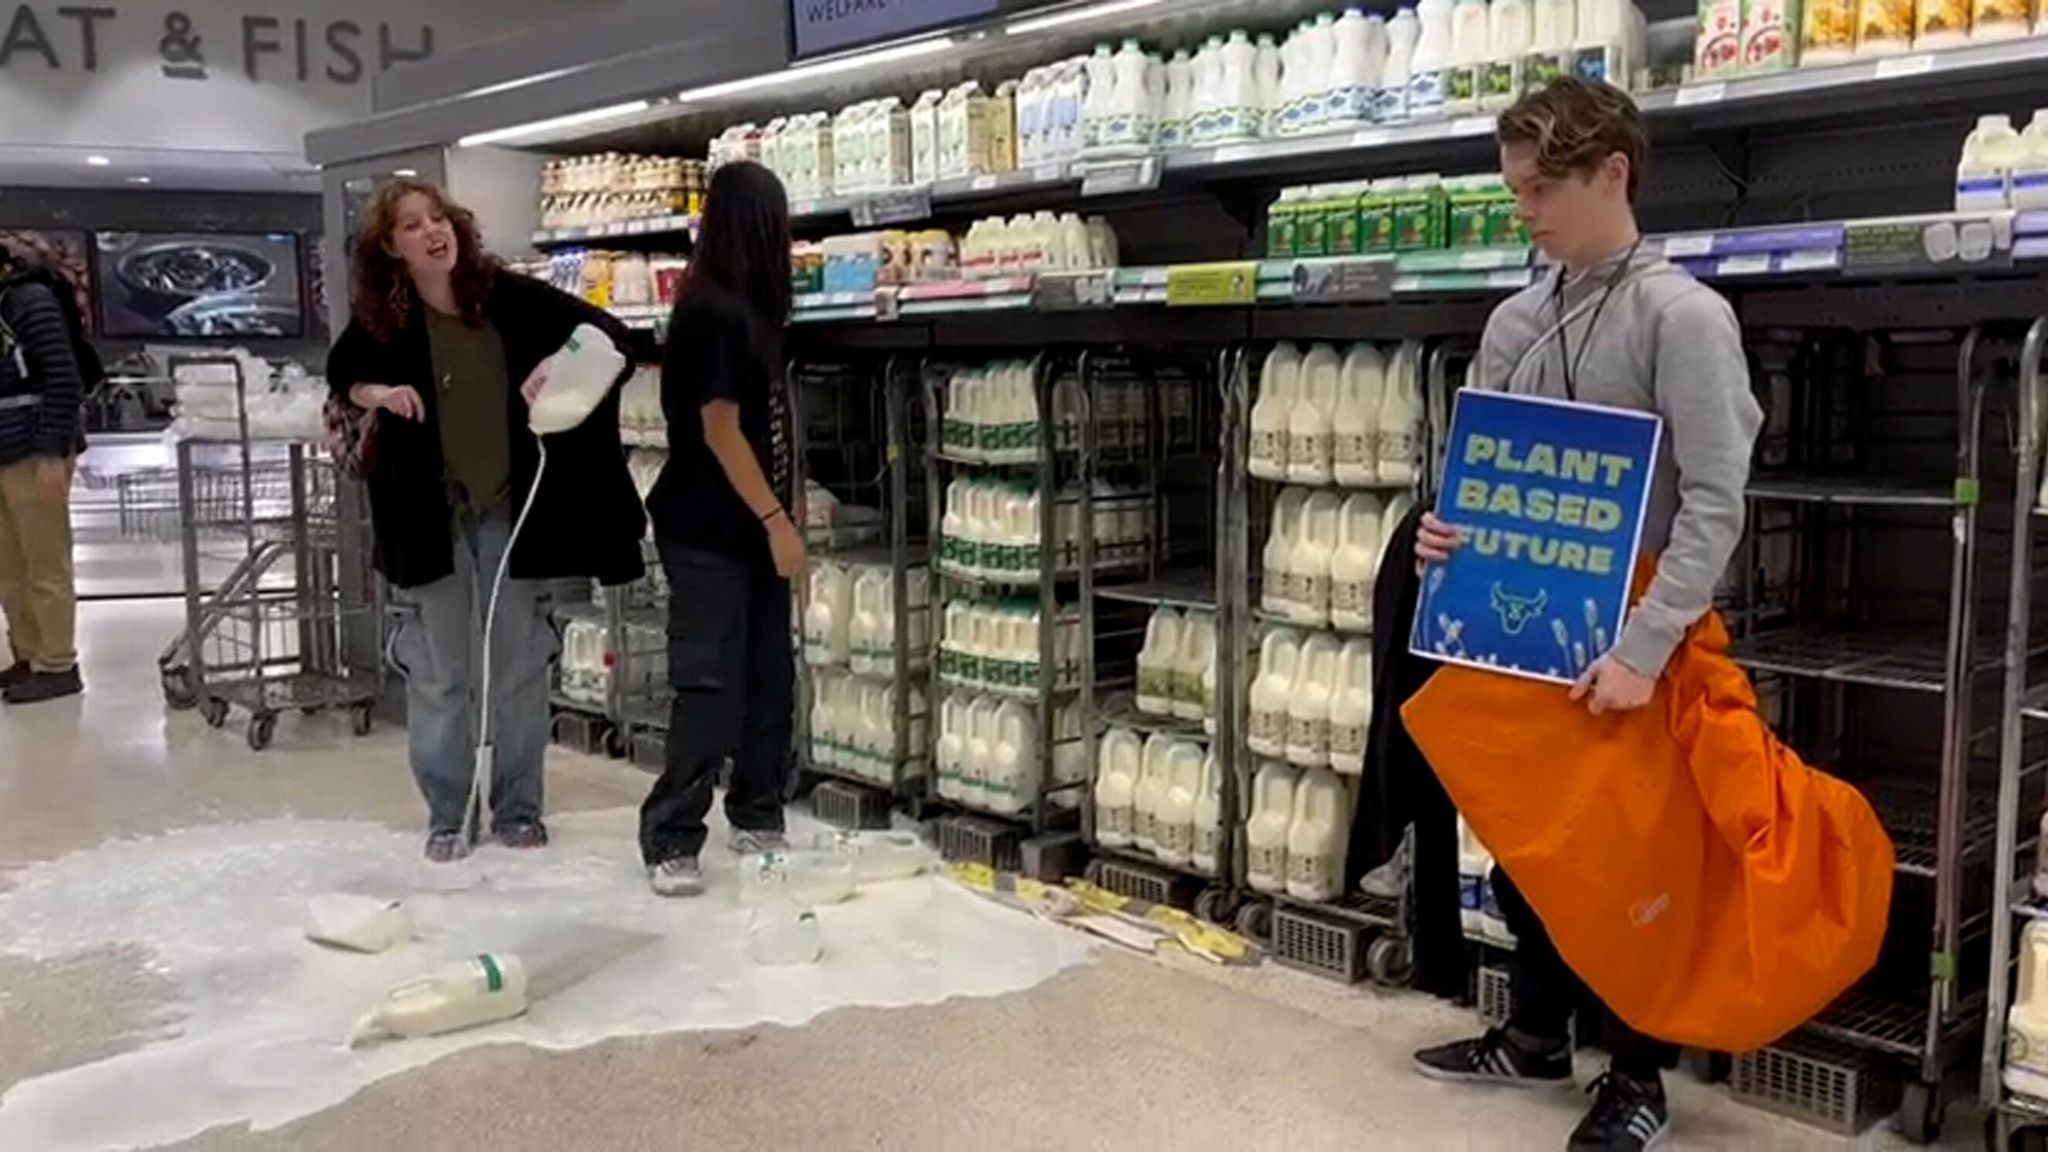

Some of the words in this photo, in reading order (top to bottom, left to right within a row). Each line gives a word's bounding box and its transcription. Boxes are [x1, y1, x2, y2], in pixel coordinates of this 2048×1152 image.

[158, 11, 207, 80] &
[1463, 433, 1633, 487] PLANT
[1456, 477, 1623, 532] BASED
